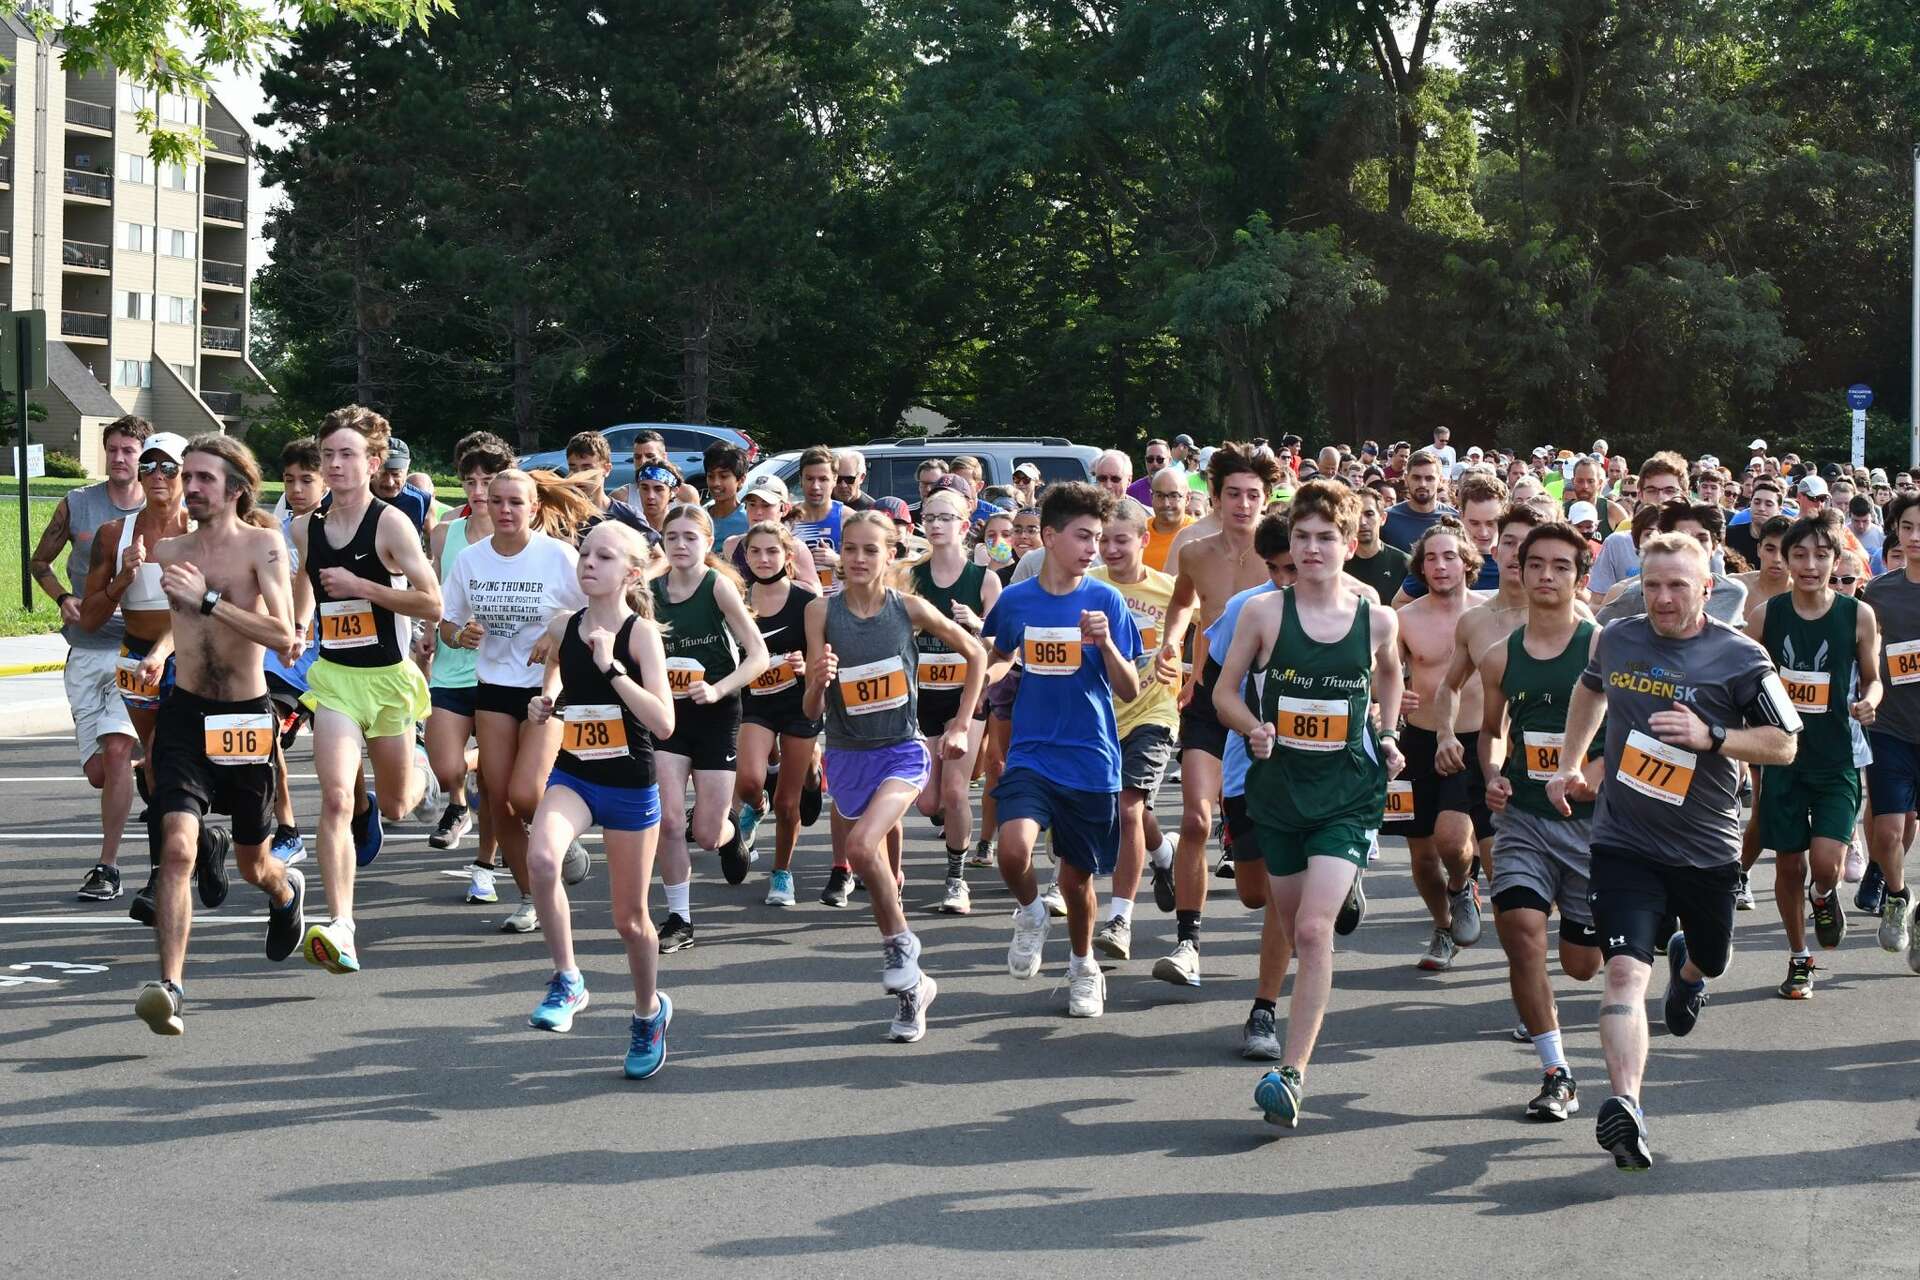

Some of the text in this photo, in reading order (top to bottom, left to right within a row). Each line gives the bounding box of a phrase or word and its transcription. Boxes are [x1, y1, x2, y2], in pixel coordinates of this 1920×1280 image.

[501, 582, 543, 592] THUNDER
[511, 605, 538, 613] NEGATIVE
[515, 596, 541, 604] POSITIVE
[1125, 597, 1164, 619] OLLOS
[331, 615, 361, 637] 743
[680, 634, 719, 648] Thunder
[1035, 642, 1066, 663] 965
[668, 671, 690, 689] 844
[758, 668, 784, 686] 862
[930, 665, 956, 681] 847
[857, 675, 889, 702] 877
[1788, 683, 1816, 702] 840
[573, 722, 610, 746] 738
[1294, 715, 1330, 738] 861
[223, 730, 256, 752] 916
[1537, 748, 1559, 769] 84
[1636, 753, 1676, 786] 777
